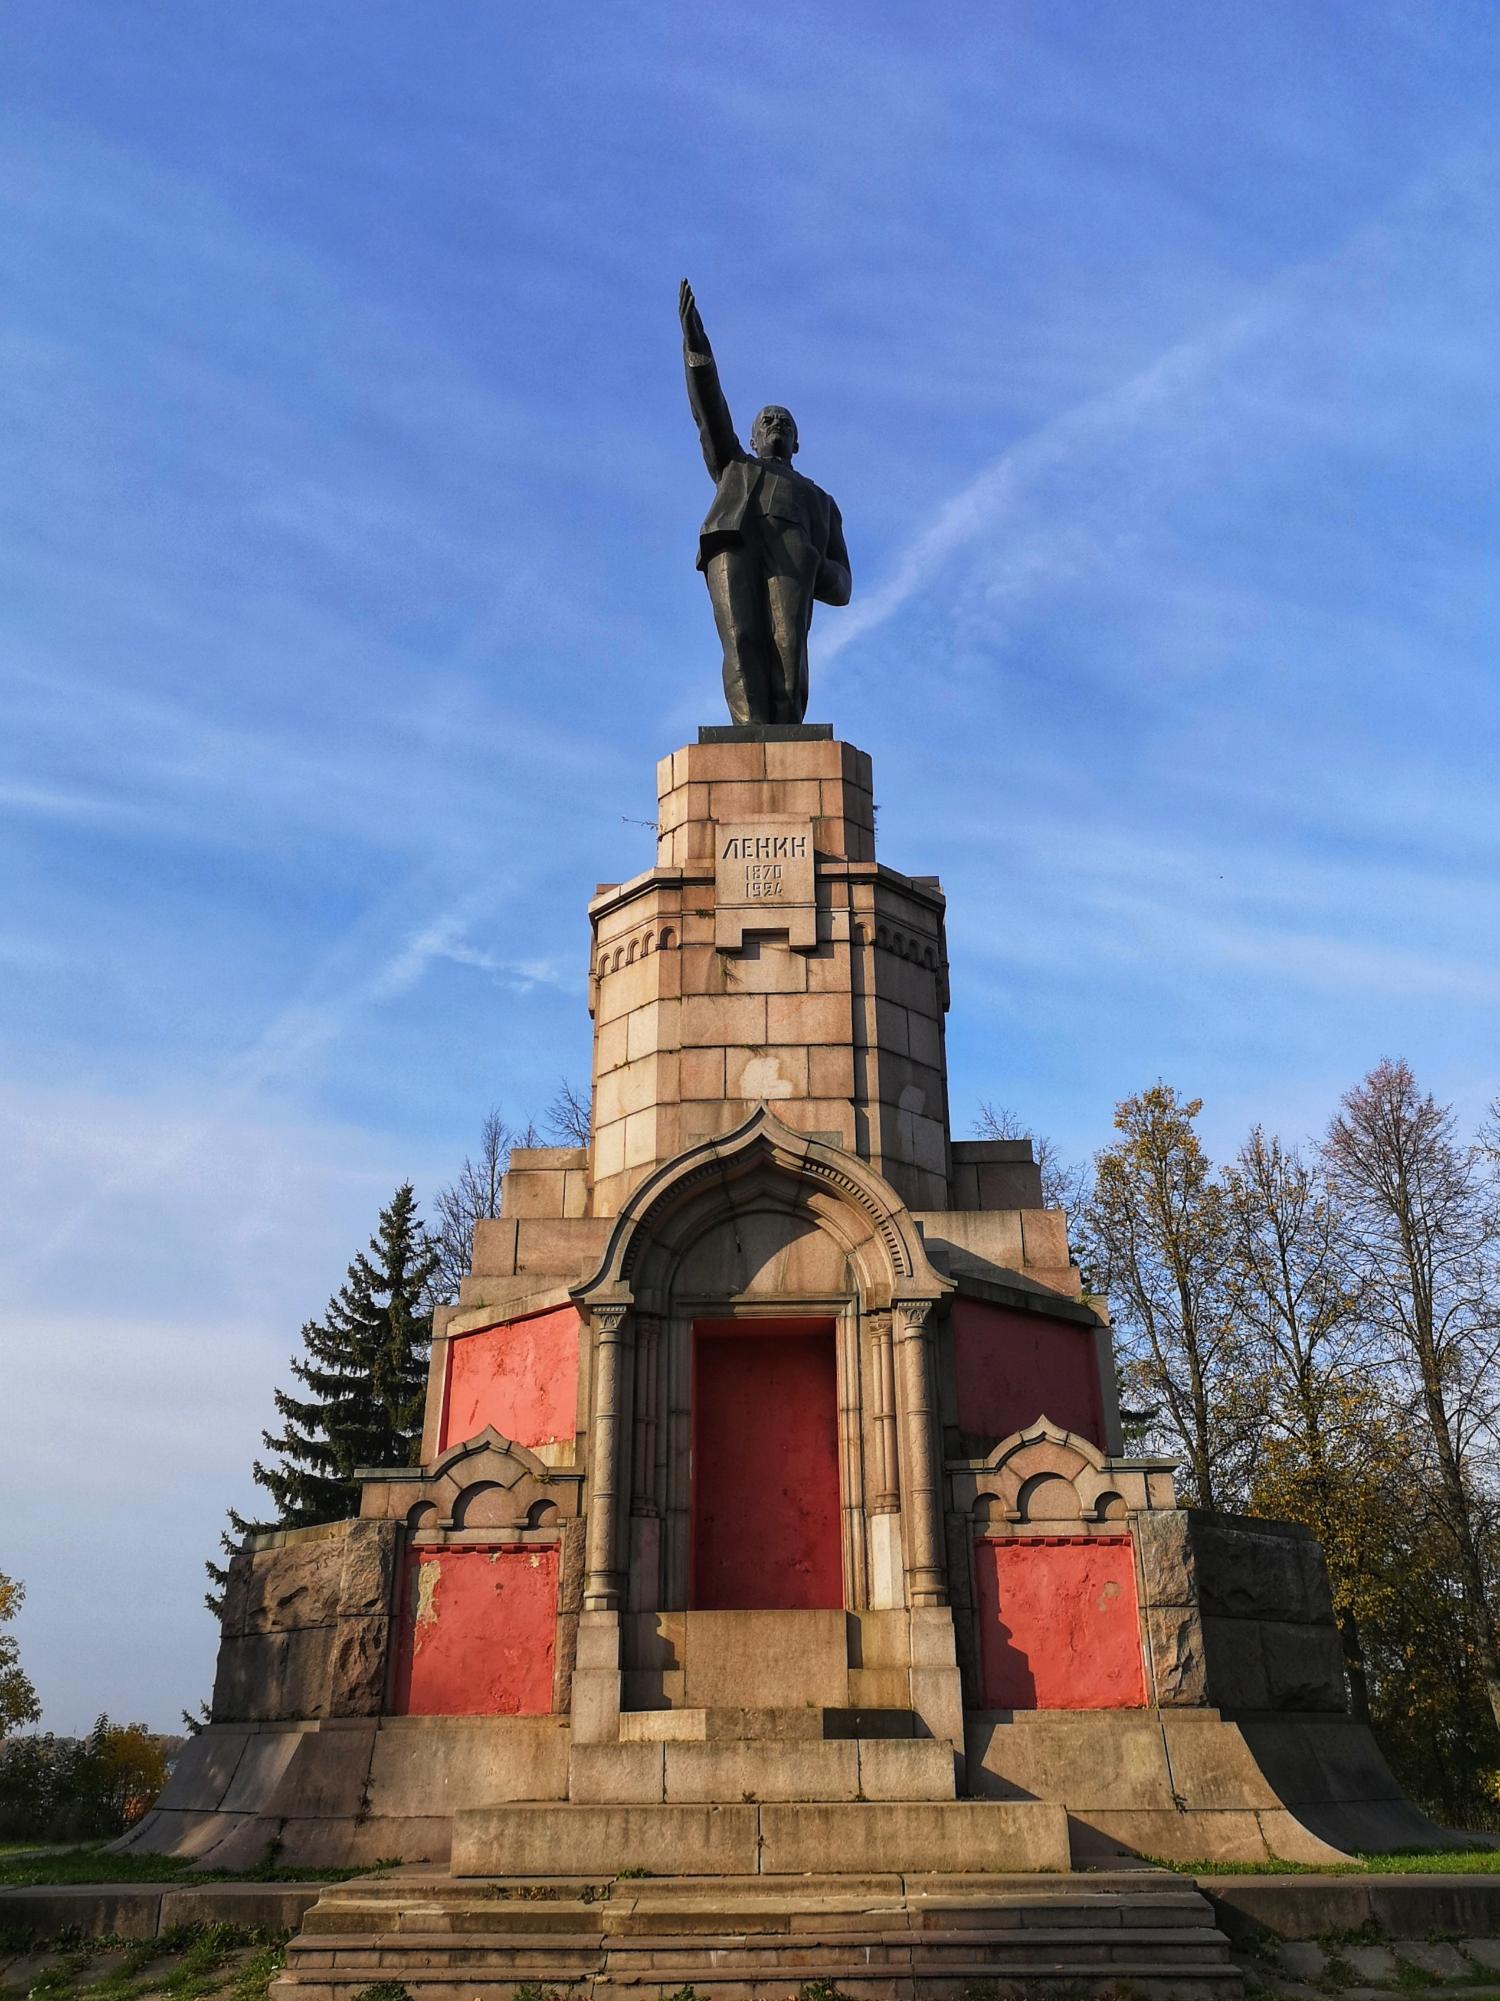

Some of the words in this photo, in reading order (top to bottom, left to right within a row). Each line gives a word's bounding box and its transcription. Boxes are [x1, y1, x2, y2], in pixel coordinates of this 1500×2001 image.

[722, 837, 806, 859] ЛЕНИН
[745, 864, 782, 880] 1870
[745, 881, 783, 898] 1924
